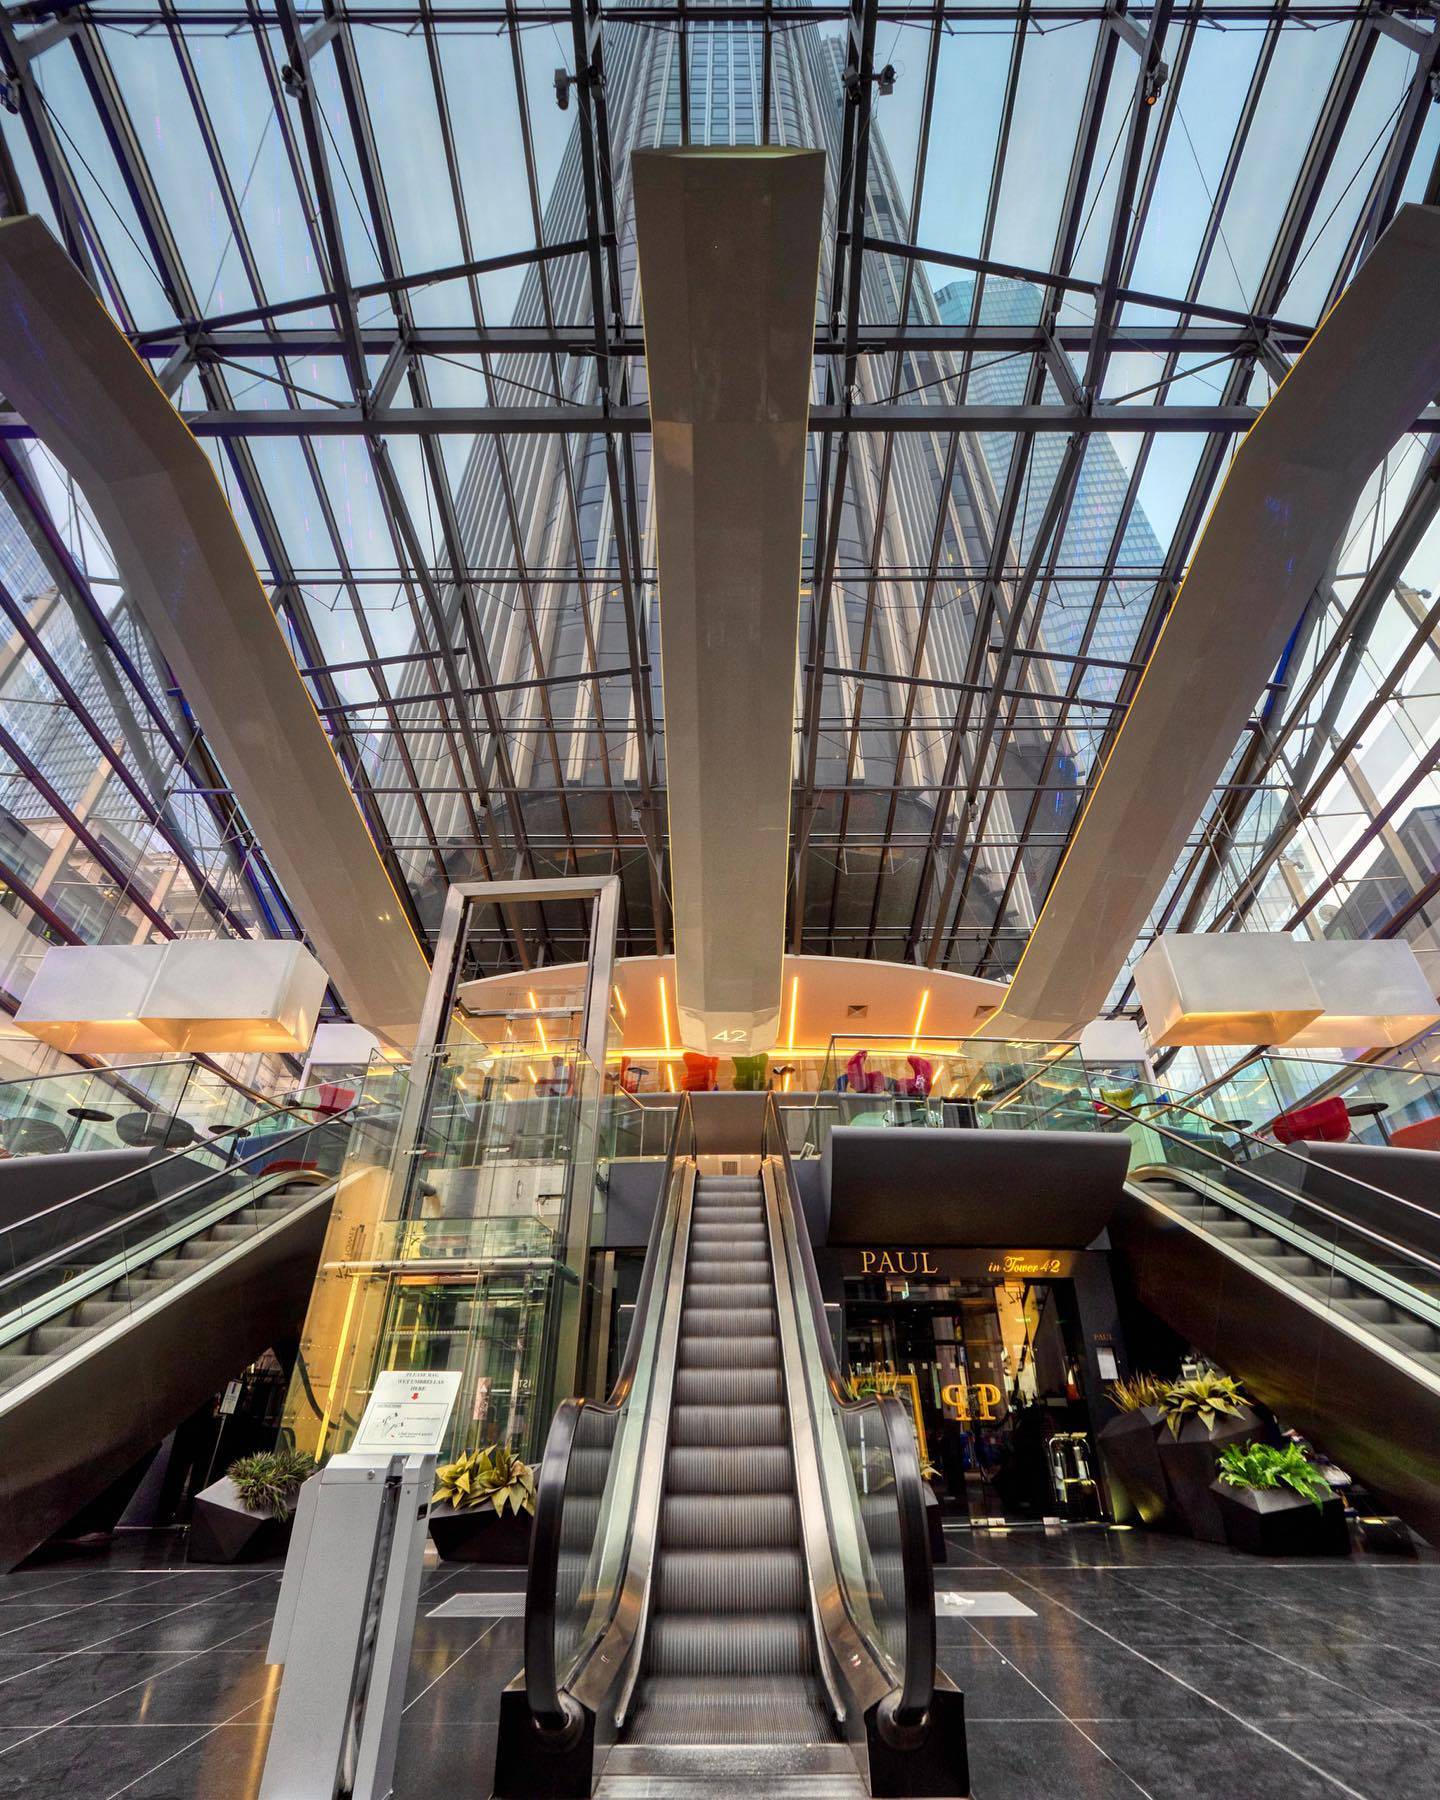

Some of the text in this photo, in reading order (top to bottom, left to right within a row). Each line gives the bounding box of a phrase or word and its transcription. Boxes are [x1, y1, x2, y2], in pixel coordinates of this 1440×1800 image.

[712, 1030, 747, 1042] 42
[860, 1251, 938, 1273] PAUL
[988, 1256, 1061, 1273] in Tower 42
[1094, 1333, 1112, 1341] PAUL
